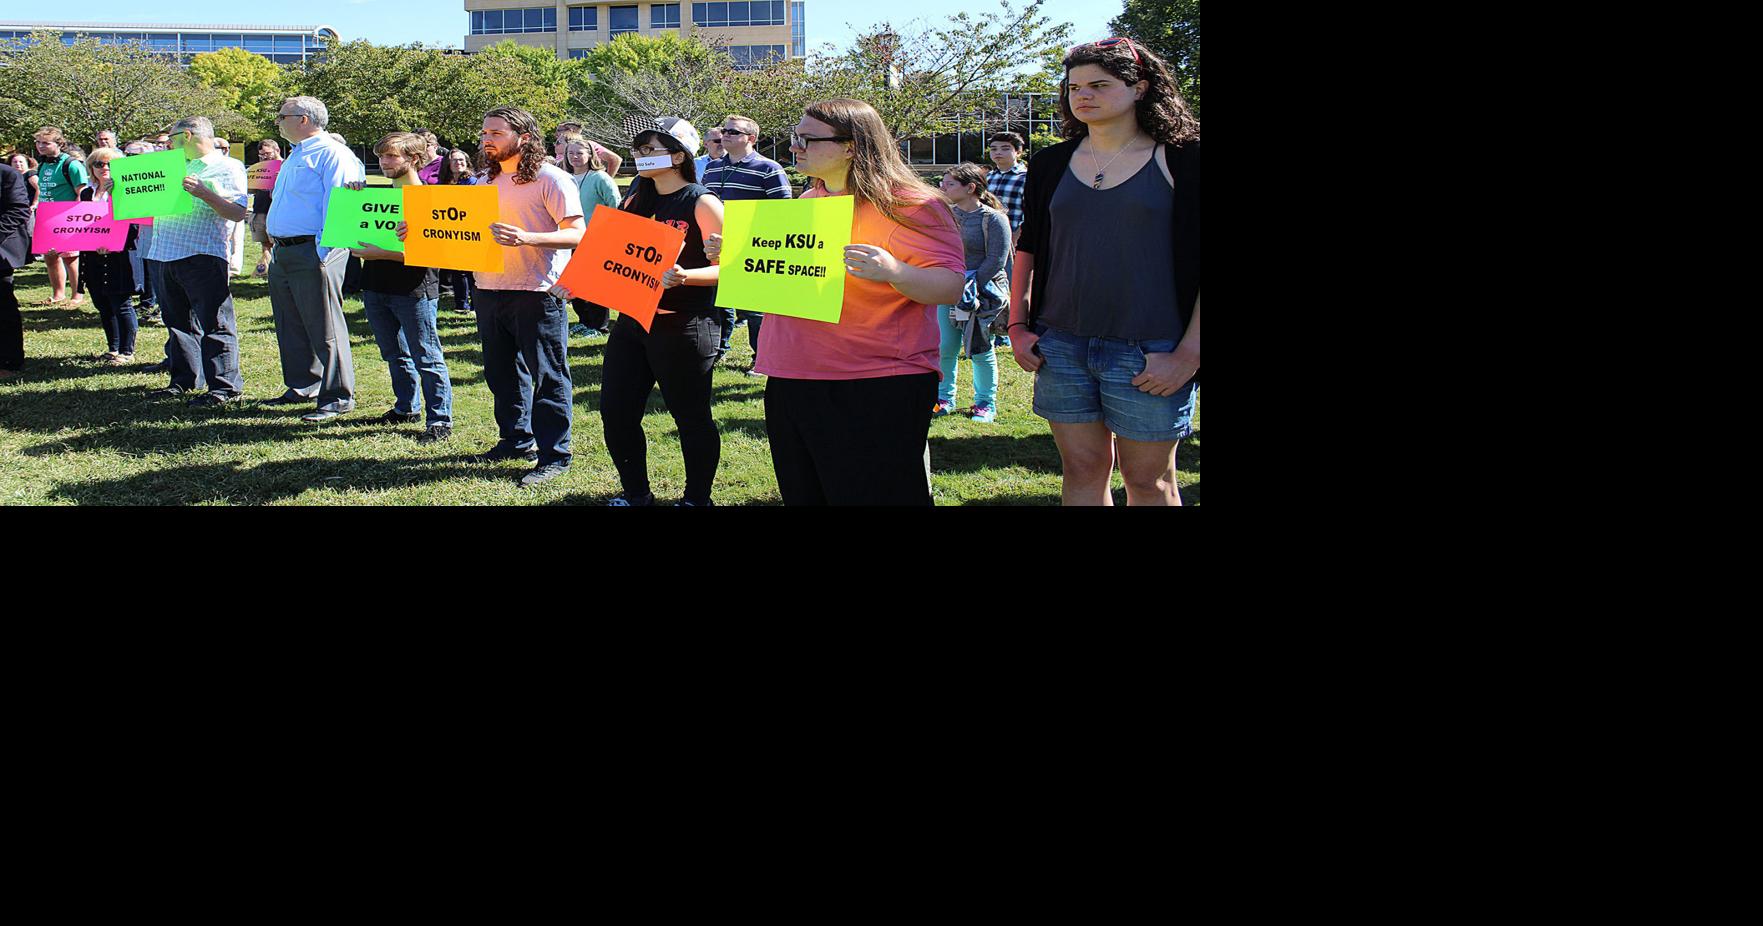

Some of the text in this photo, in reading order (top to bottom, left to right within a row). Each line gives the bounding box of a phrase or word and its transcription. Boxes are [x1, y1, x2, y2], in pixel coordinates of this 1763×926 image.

[121, 170, 166, 182] NATIONAL
[125, 183, 166, 195] SEARCH!!
[361, 202, 400, 214] GIVE
[432, 207, 467, 221] STOP
[66, 213, 102, 222] STOP
[359, 219, 401, 231] a VO
[423, 228, 481, 242] CRONYISM
[751, 233, 824, 250] Keep KSU a
[625, 242, 663, 265] STOP
[744, 258, 827, 278] SAFE SPACE!!
